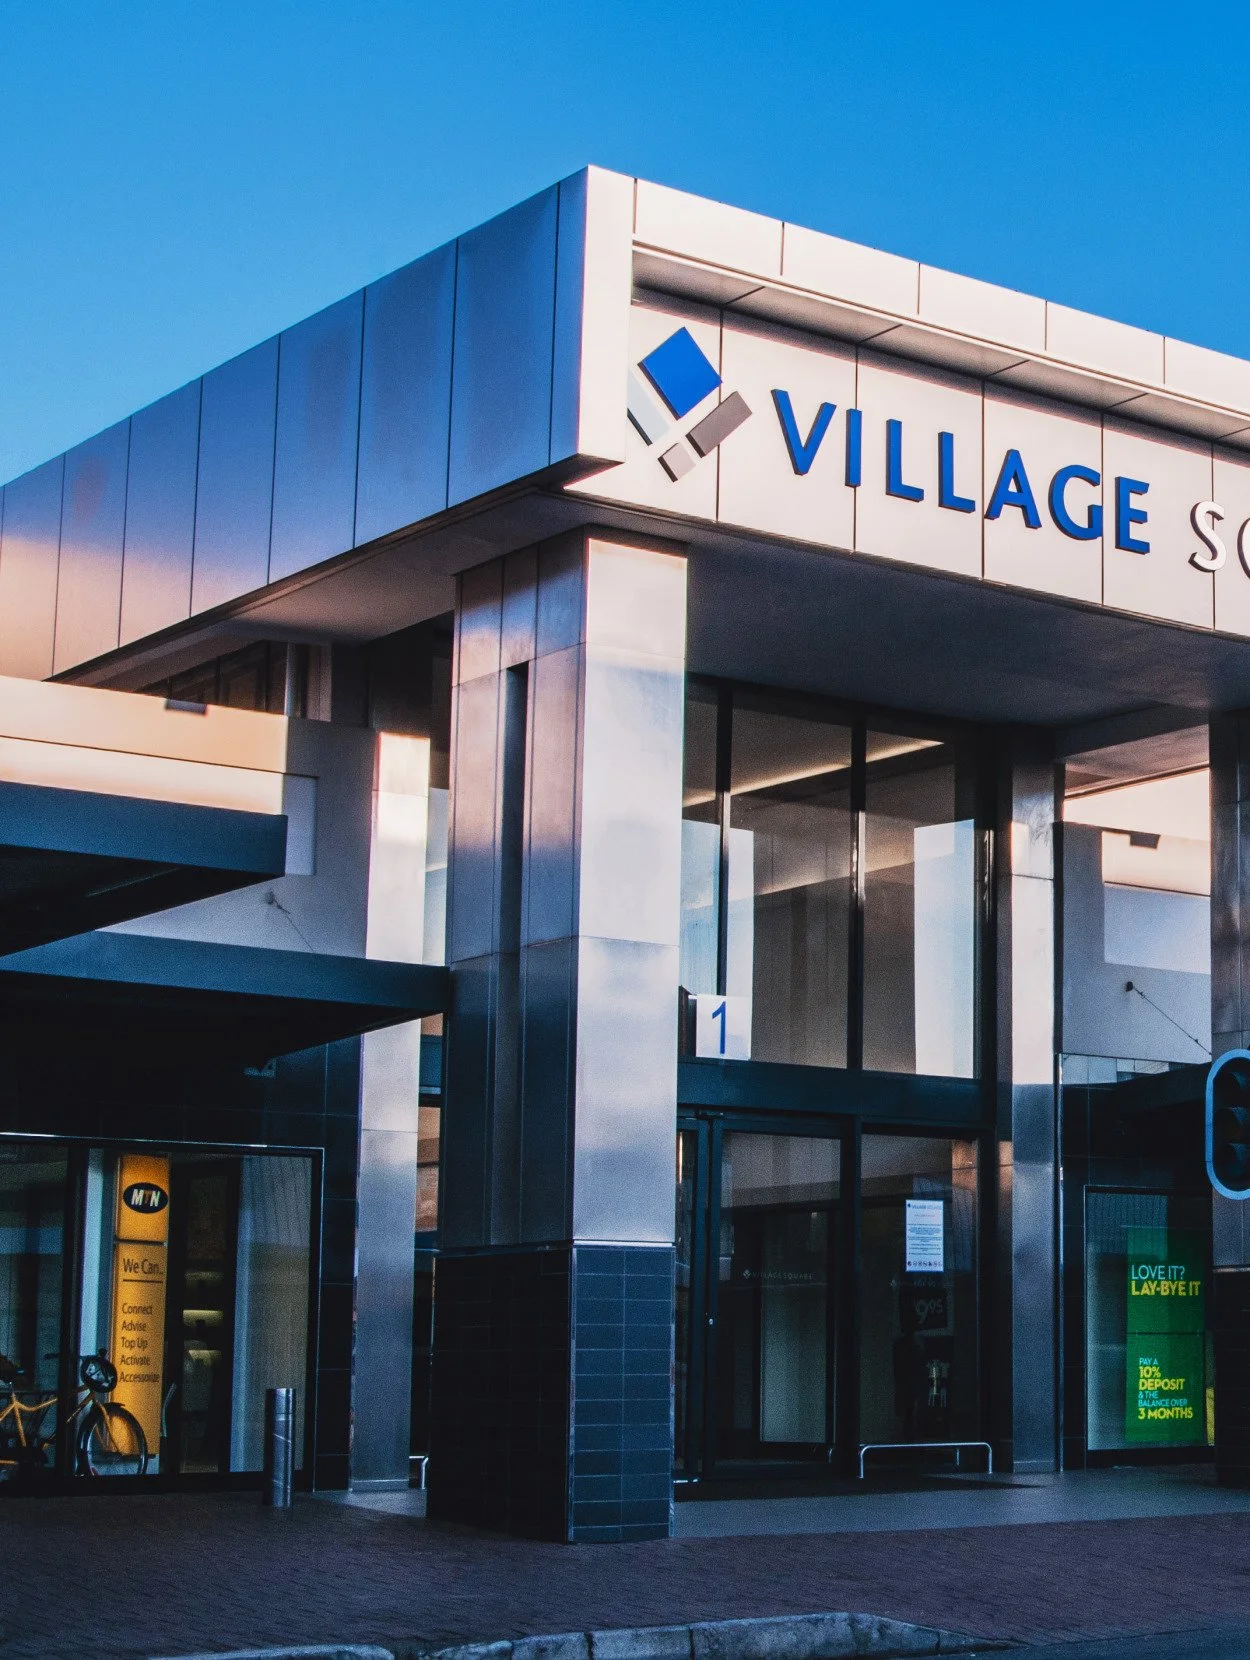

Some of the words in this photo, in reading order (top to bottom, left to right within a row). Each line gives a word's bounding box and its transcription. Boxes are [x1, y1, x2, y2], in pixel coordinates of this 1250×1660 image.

[771, 388, 1150, 555] VILLAGE
[711, 1000, 727, 1055] 1
[131, 1188, 160, 1207] MTN
[123, 1258, 139, 1274] We
[1131, 1265, 1166, 1280] LOVE
[1168, 1265, 1185, 1280] IT?
[1131, 1280, 1186, 1296] LAY-BYE
[1189, 1281, 1201, 1296] IT
[122, 1303, 153, 1315] Connect
[121, 1320, 147, 1332] Advise
[121, 1337, 136, 1351] Top
[137, 1337, 148, 1351] Up
[120, 1354, 151, 1366] Activate
[1139, 1357, 1152, 1365] PAY
[1139, 1366, 1161, 1378] 10%
[1138, 1379, 1185, 1390] DEPOSIT
[1138, 1391, 1144, 1399] &
[1145, 1391, 1158, 1399] THE
[1138, 1398, 1169, 1407] BALANCE
[1138, 1407, 1146, 1420] 3
[1147, 1407, 1193, 1419] MONTHS
